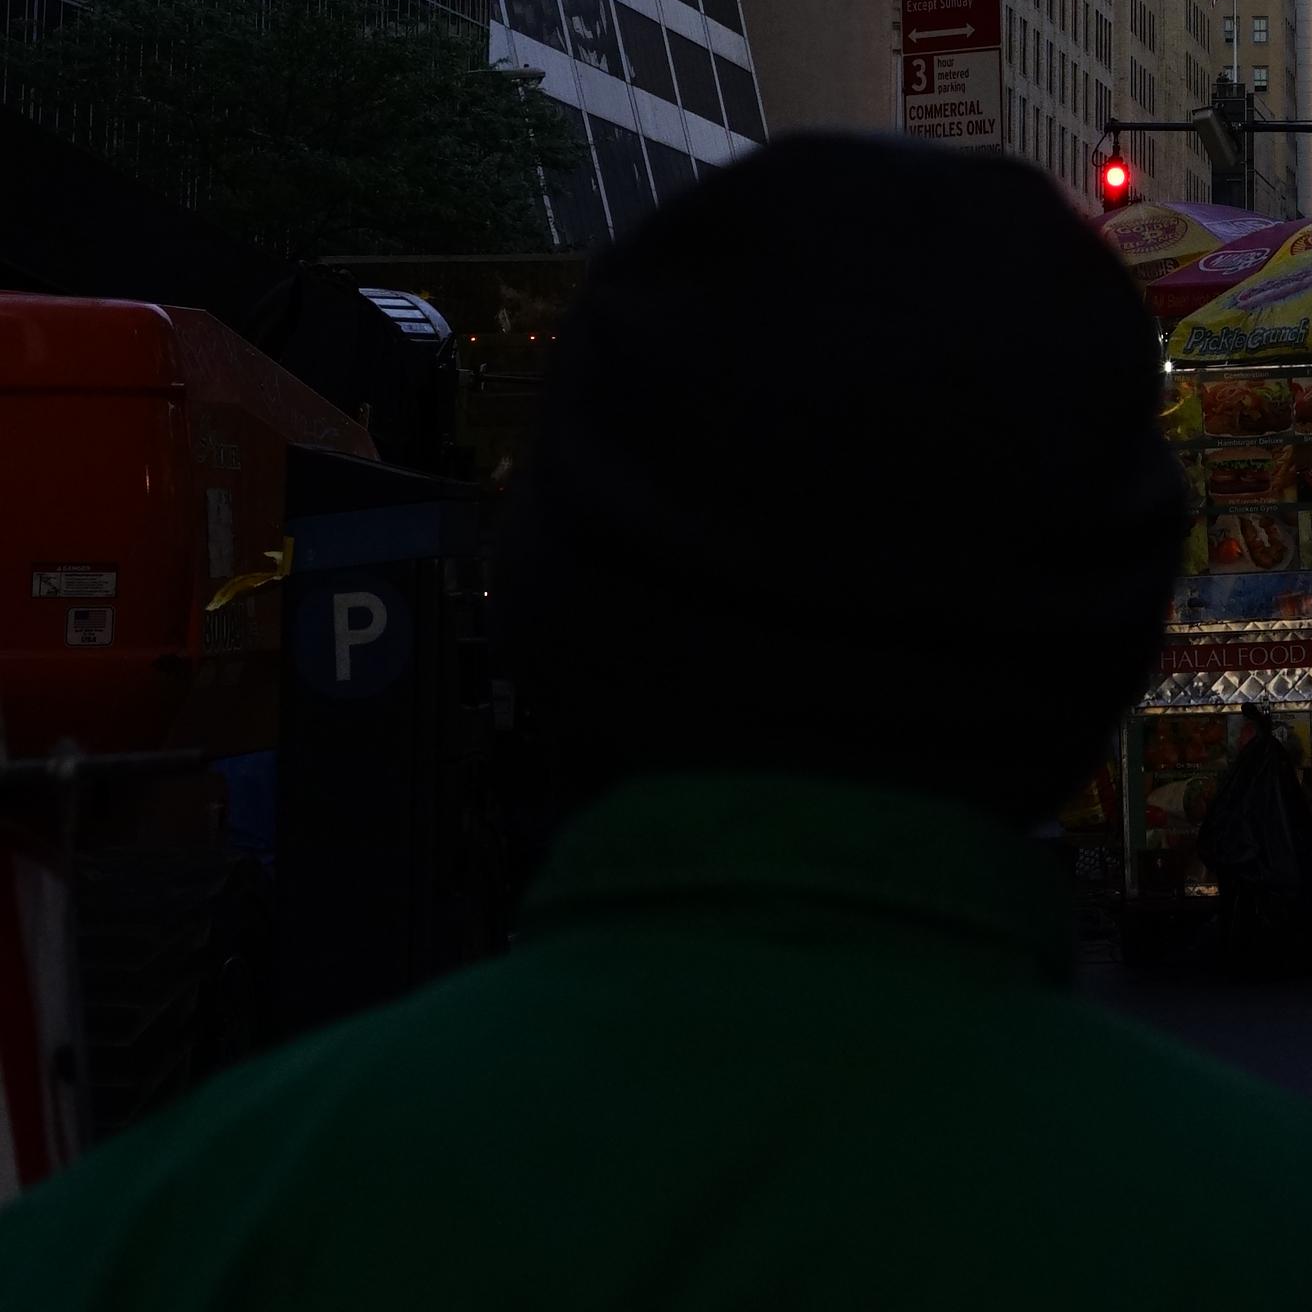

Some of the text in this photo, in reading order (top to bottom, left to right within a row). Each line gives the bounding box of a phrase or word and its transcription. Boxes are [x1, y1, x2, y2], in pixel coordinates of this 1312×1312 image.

[937, 59, 954, 68] hour
[912, 58, 928, 92] 3
[937, 68, 970, 80] metered
[938, 82, 966, 94] parking
[909, 100, 983, 120] COMMERCIAL
[909, 118, 995, 138] VEHICLES ONLY
[1217, 439, 1257, 448] Hamburger
[332, 591, 388, 681] P
[1159, 643, 1307, 670] HALAL FOOD
